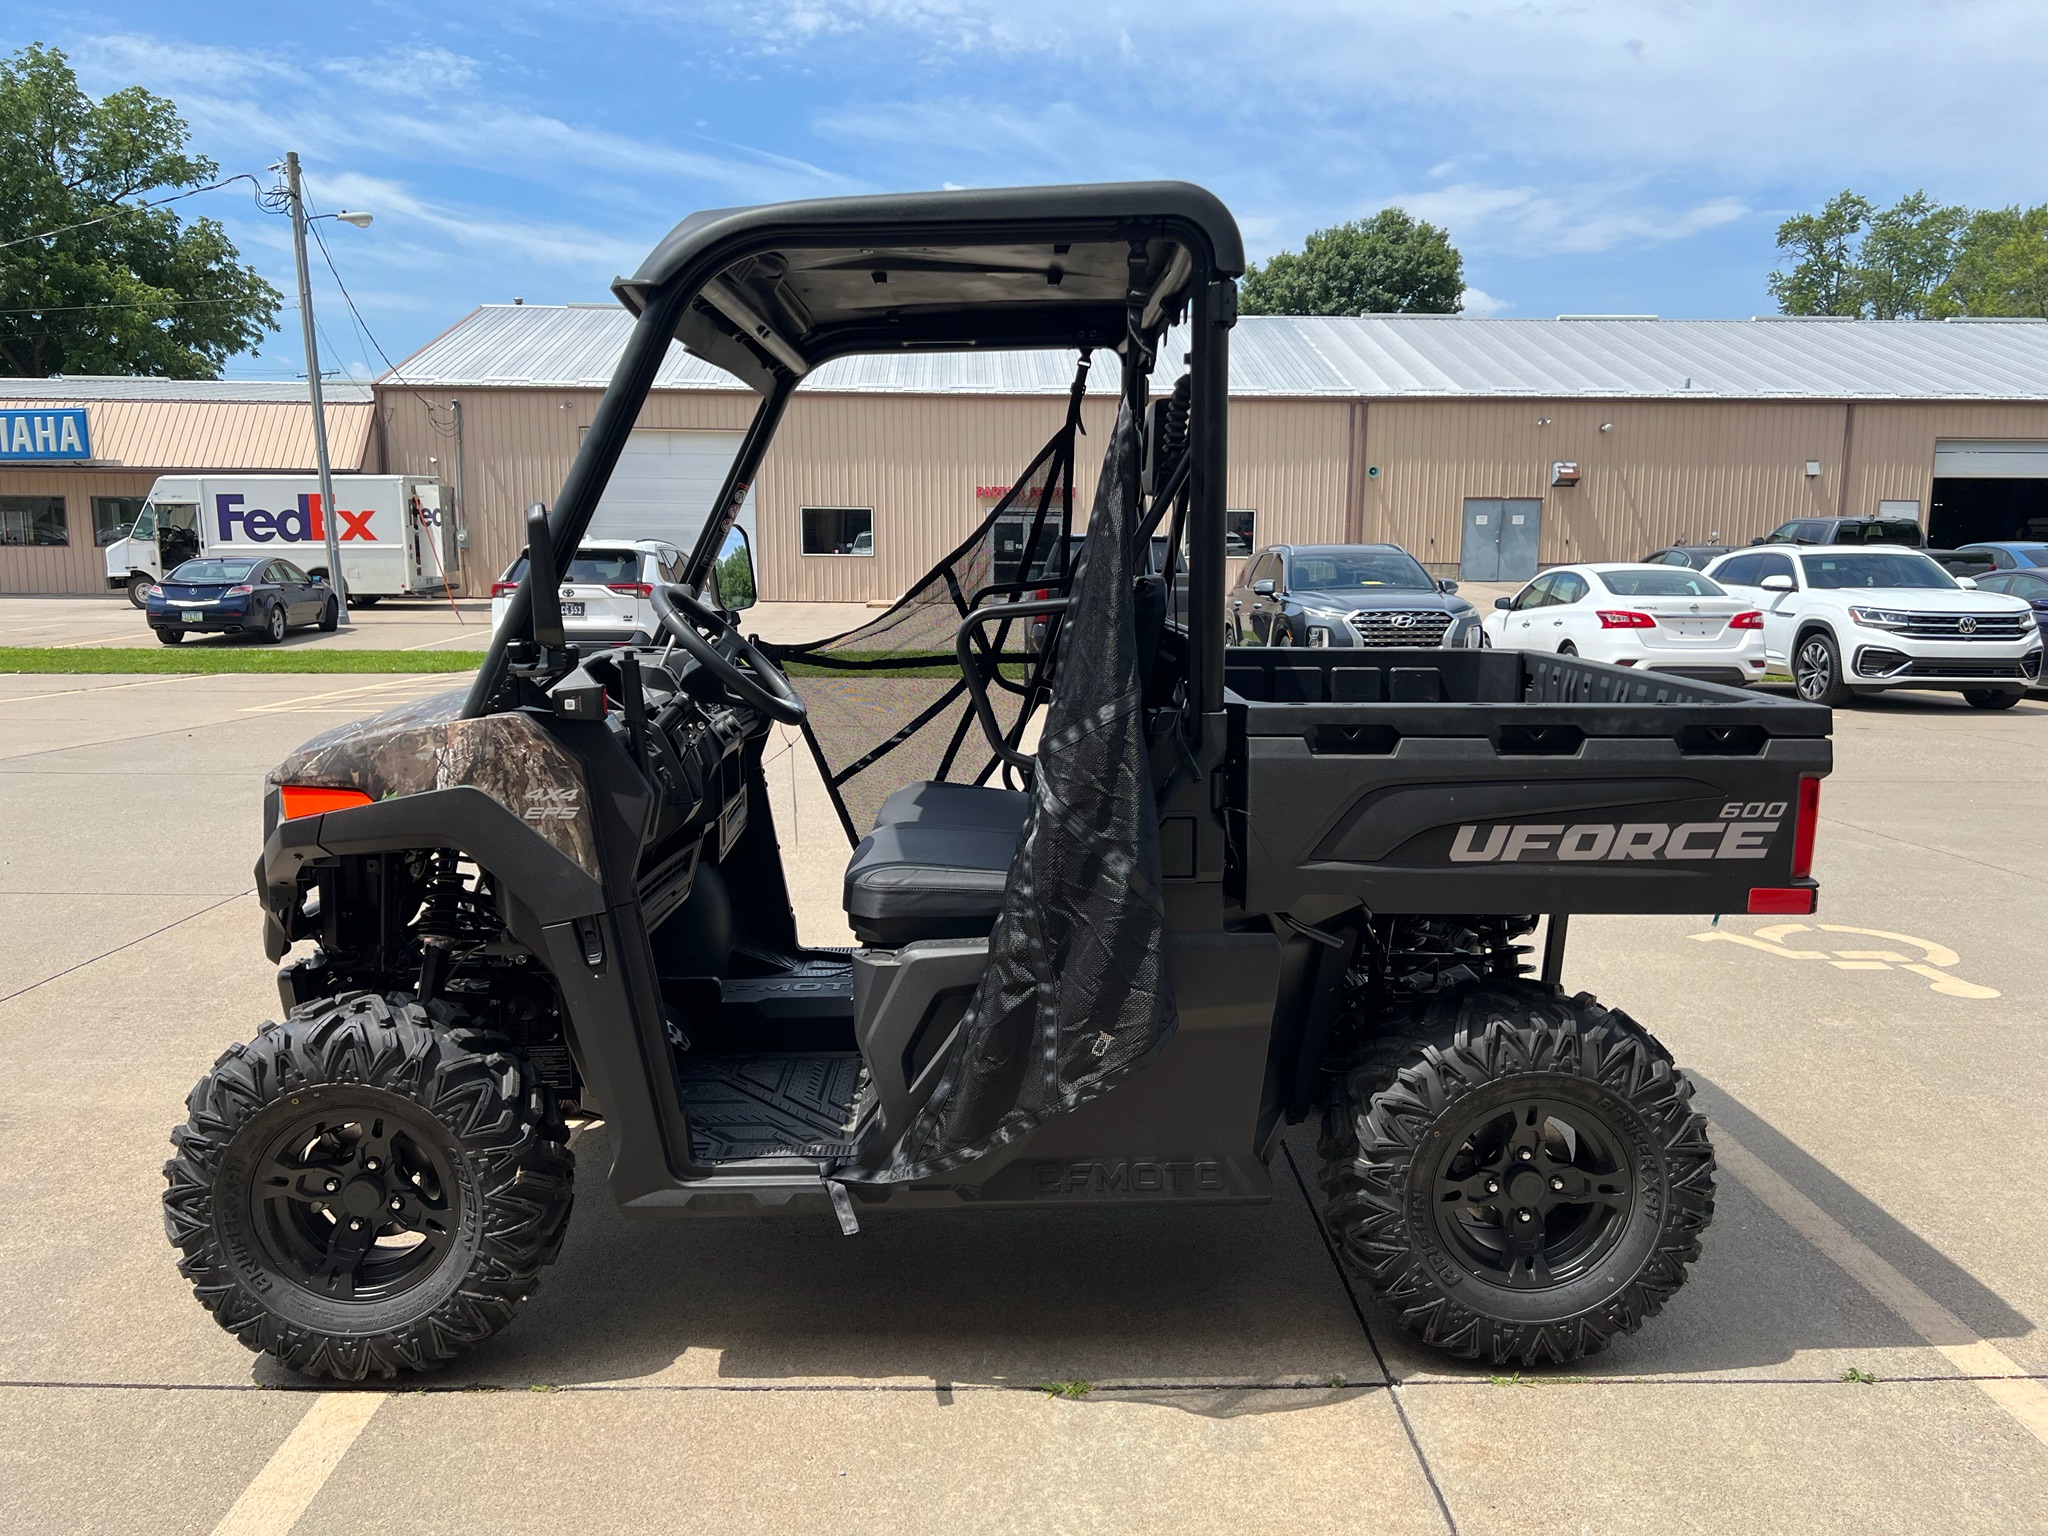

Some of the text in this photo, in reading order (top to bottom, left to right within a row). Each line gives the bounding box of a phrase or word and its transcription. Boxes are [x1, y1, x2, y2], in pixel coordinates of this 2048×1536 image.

[523, 788, 580, 801] 4X4
[523, 806, 581, 820] EPS
[1719, 802, 1787, 818] 600
[1449, 822, 1780, 861] UFORCE
[1031, 1161, 1224, 1193] CFMOTO
